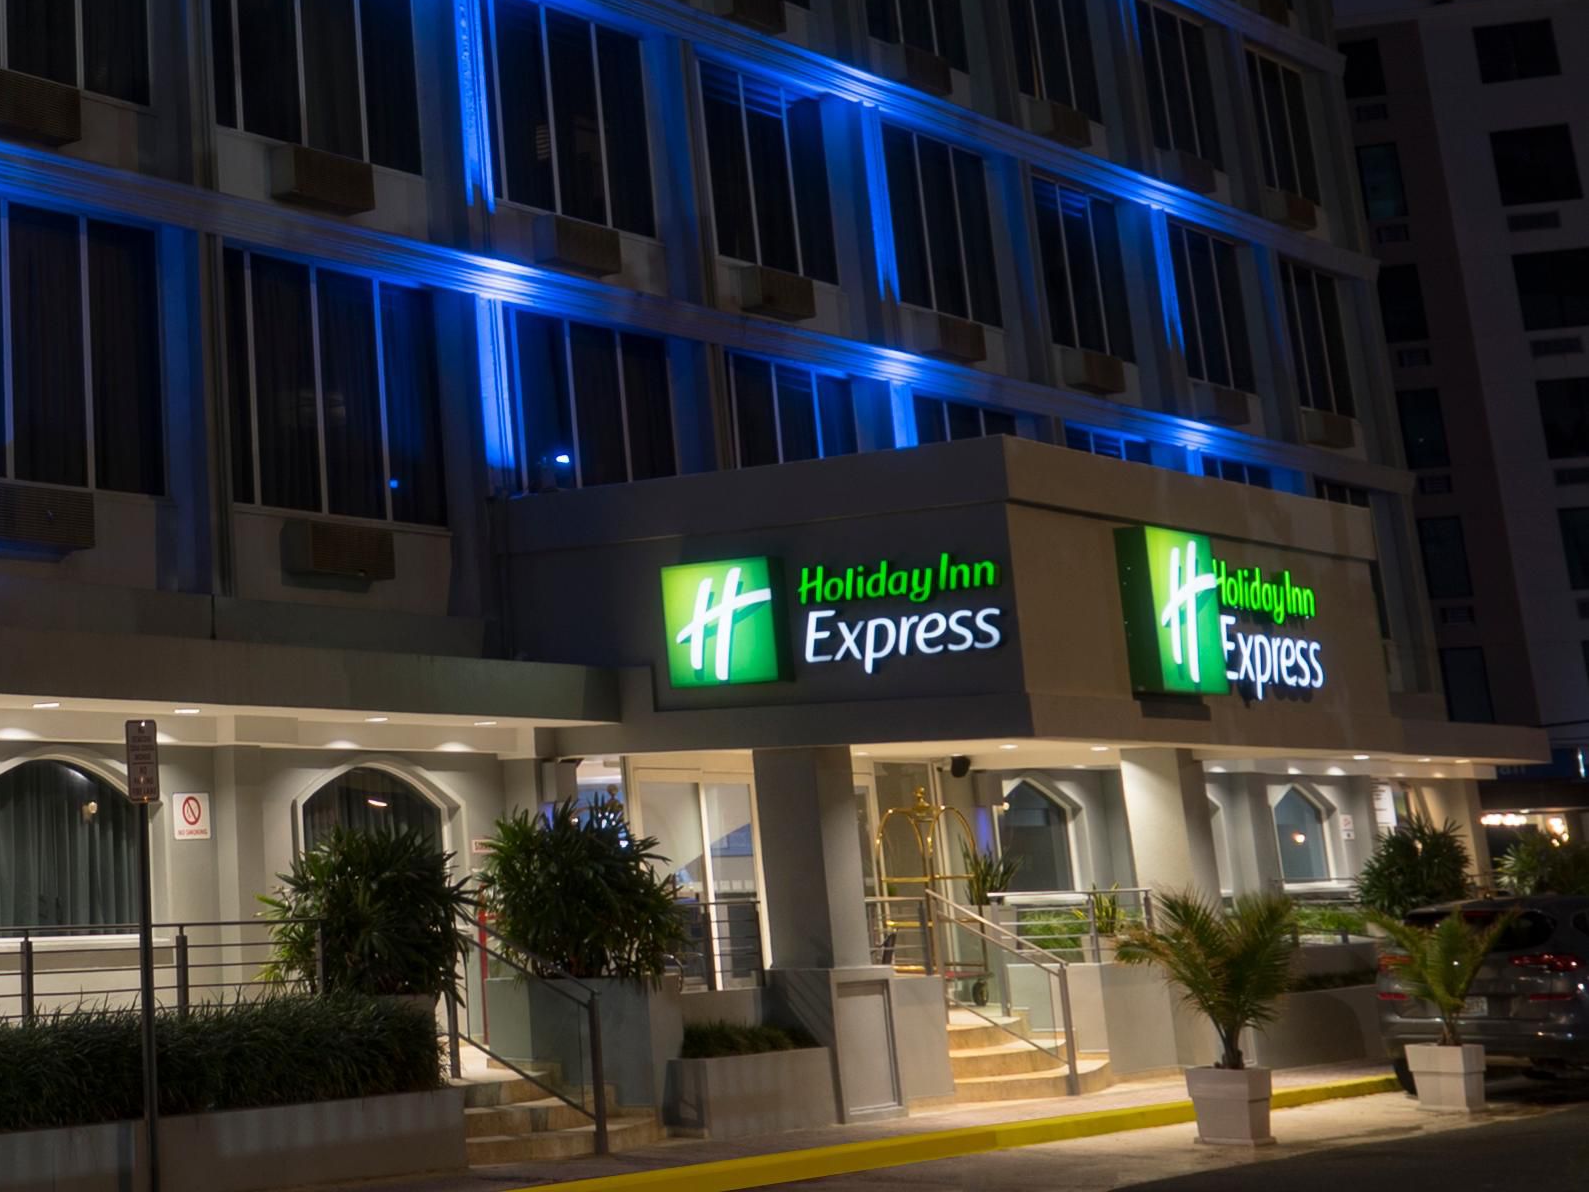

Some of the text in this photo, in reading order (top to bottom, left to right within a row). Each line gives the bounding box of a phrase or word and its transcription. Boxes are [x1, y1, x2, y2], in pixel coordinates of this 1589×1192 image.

[797, 552, 996, 605] Holiday Inn
[1212, 558, 1316, 624] Holiday Inn
[804, 607, 1002, 675] Express
[1219, 614, 1325, 701] Express
